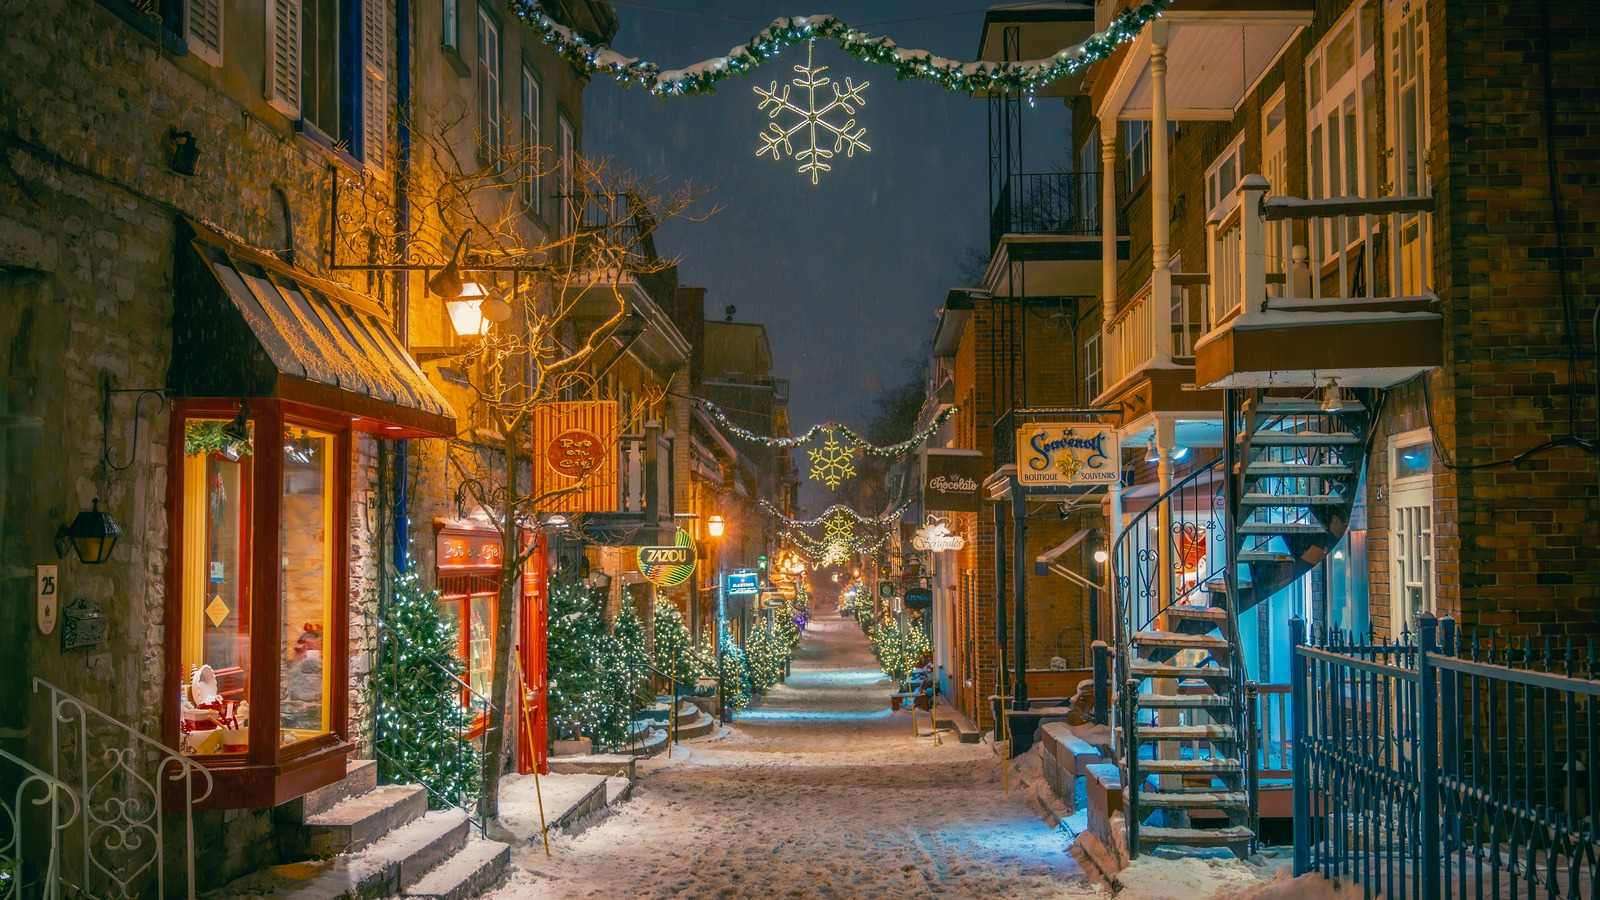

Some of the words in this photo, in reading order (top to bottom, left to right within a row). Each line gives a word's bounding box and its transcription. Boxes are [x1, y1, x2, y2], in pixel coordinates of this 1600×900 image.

[929, 475, 979, 494] Chocolato
[1024, 473, 1059, 481] BOUTIQUE
[1081, 472, 1116, 480] SOUVENIRS
[646, 549, 687, 562] ZAZOU
[41, 576, 55, 596] 25
